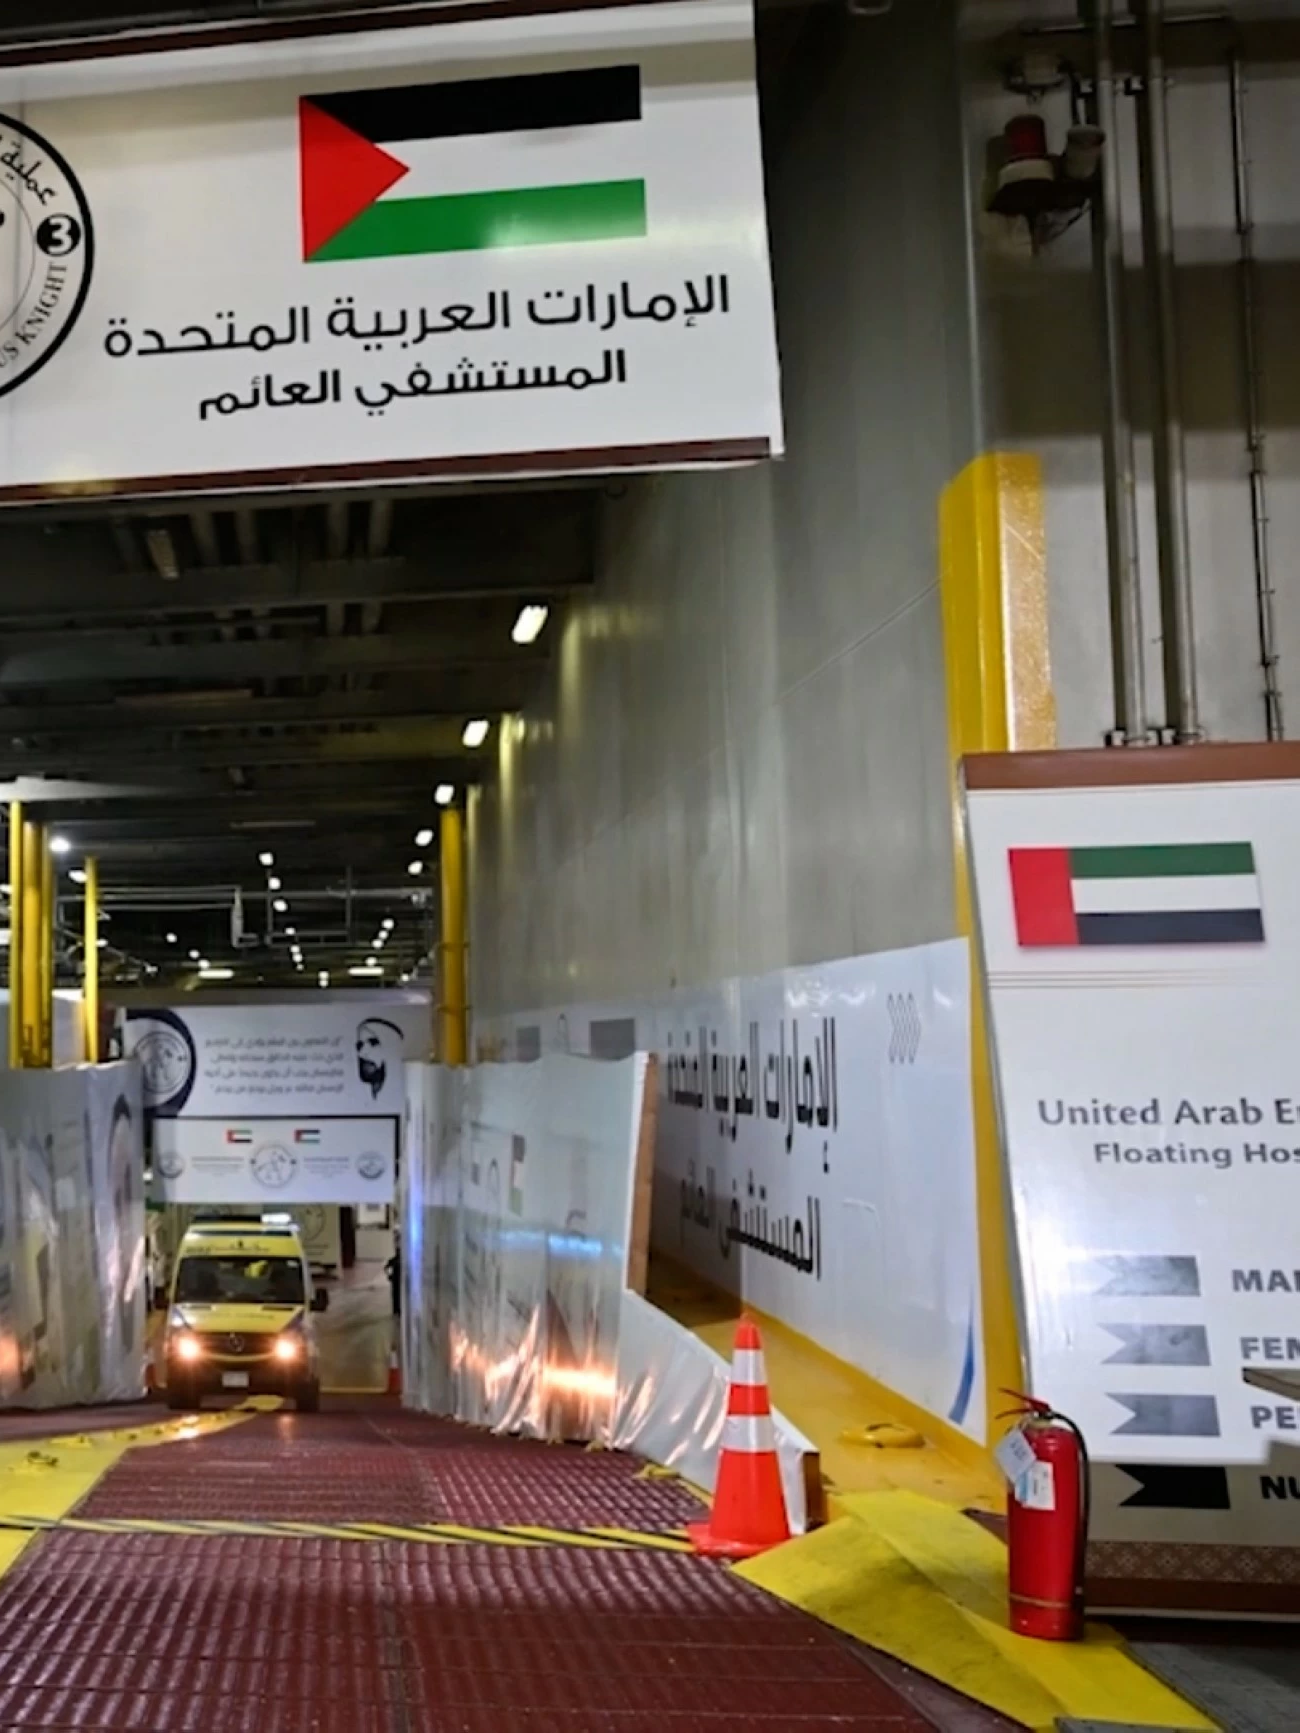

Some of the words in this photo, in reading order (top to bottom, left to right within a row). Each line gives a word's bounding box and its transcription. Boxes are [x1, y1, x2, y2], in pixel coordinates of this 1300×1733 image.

[0, 140, 55, 206] عملية
[15, 264, 68, 347] KNIGHT
[328, 289, 510, 351] العربية
[527, 274, 730, 327] الإمارات
[104, 306, 310, 357] المتحدة
[199, 369, 342, 420] العائم
[355, 349, 627, 416] المستشفي
[1037, 1097, 1161, 1126] United
[1174, 1096, 1264, 1126] Arab
[1274, 1097, 1300, 1126] E
[1094, 1142, 1233, 1169] Floating
[1250, 1405, 1300, 1430] PE
